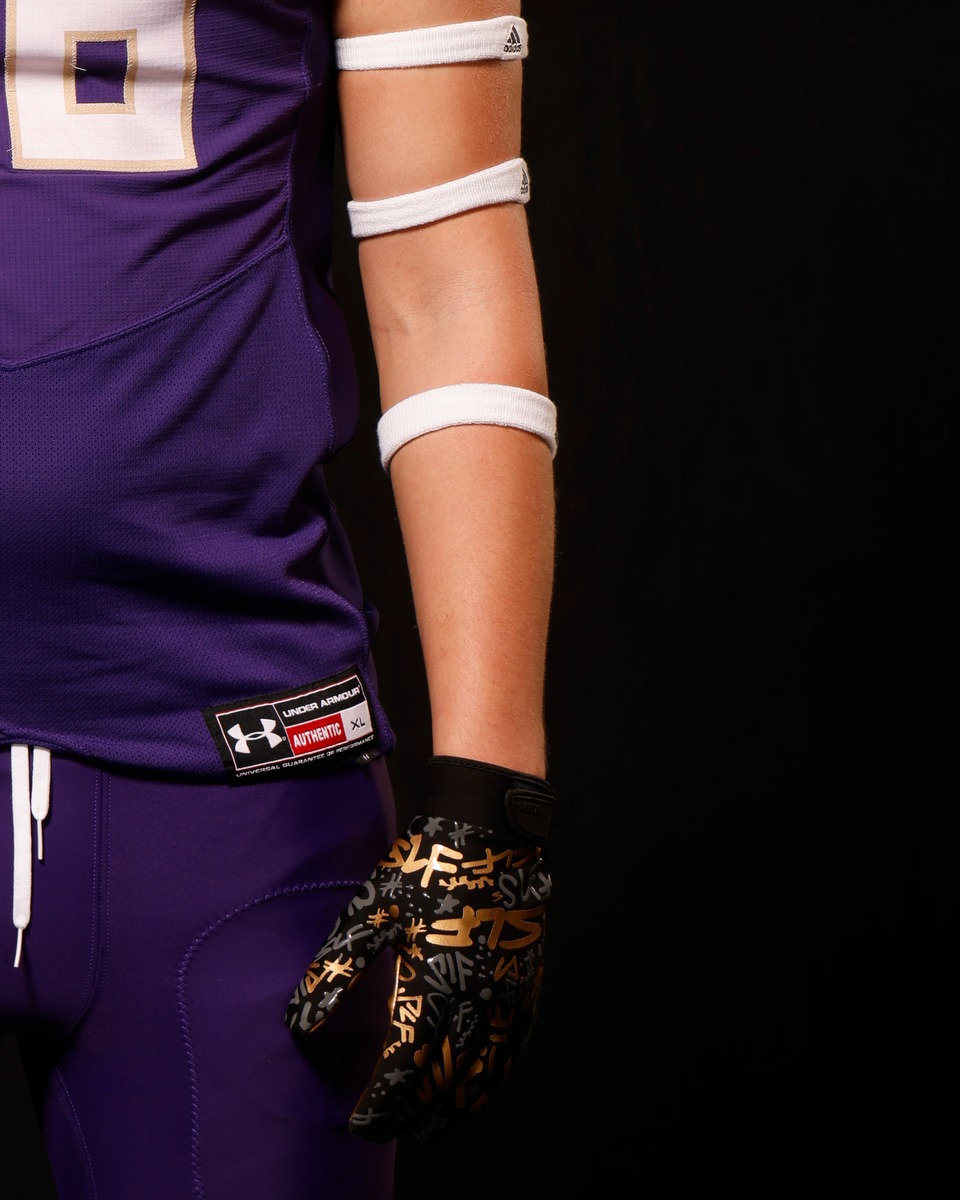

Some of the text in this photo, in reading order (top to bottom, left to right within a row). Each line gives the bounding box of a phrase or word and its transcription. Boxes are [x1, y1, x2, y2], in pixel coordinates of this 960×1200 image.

[282, 686, 360, 718] UNDER ARMOUR
[292, 722, 341, 748] AUTHENTIC
[350, 717, 366, 731] XL
[236, 764, 281, 777] UNIVERSAL
[282, 753, 325, 768] GUARANTEE
[335, 734, 374, 753] PERFORMANCE
